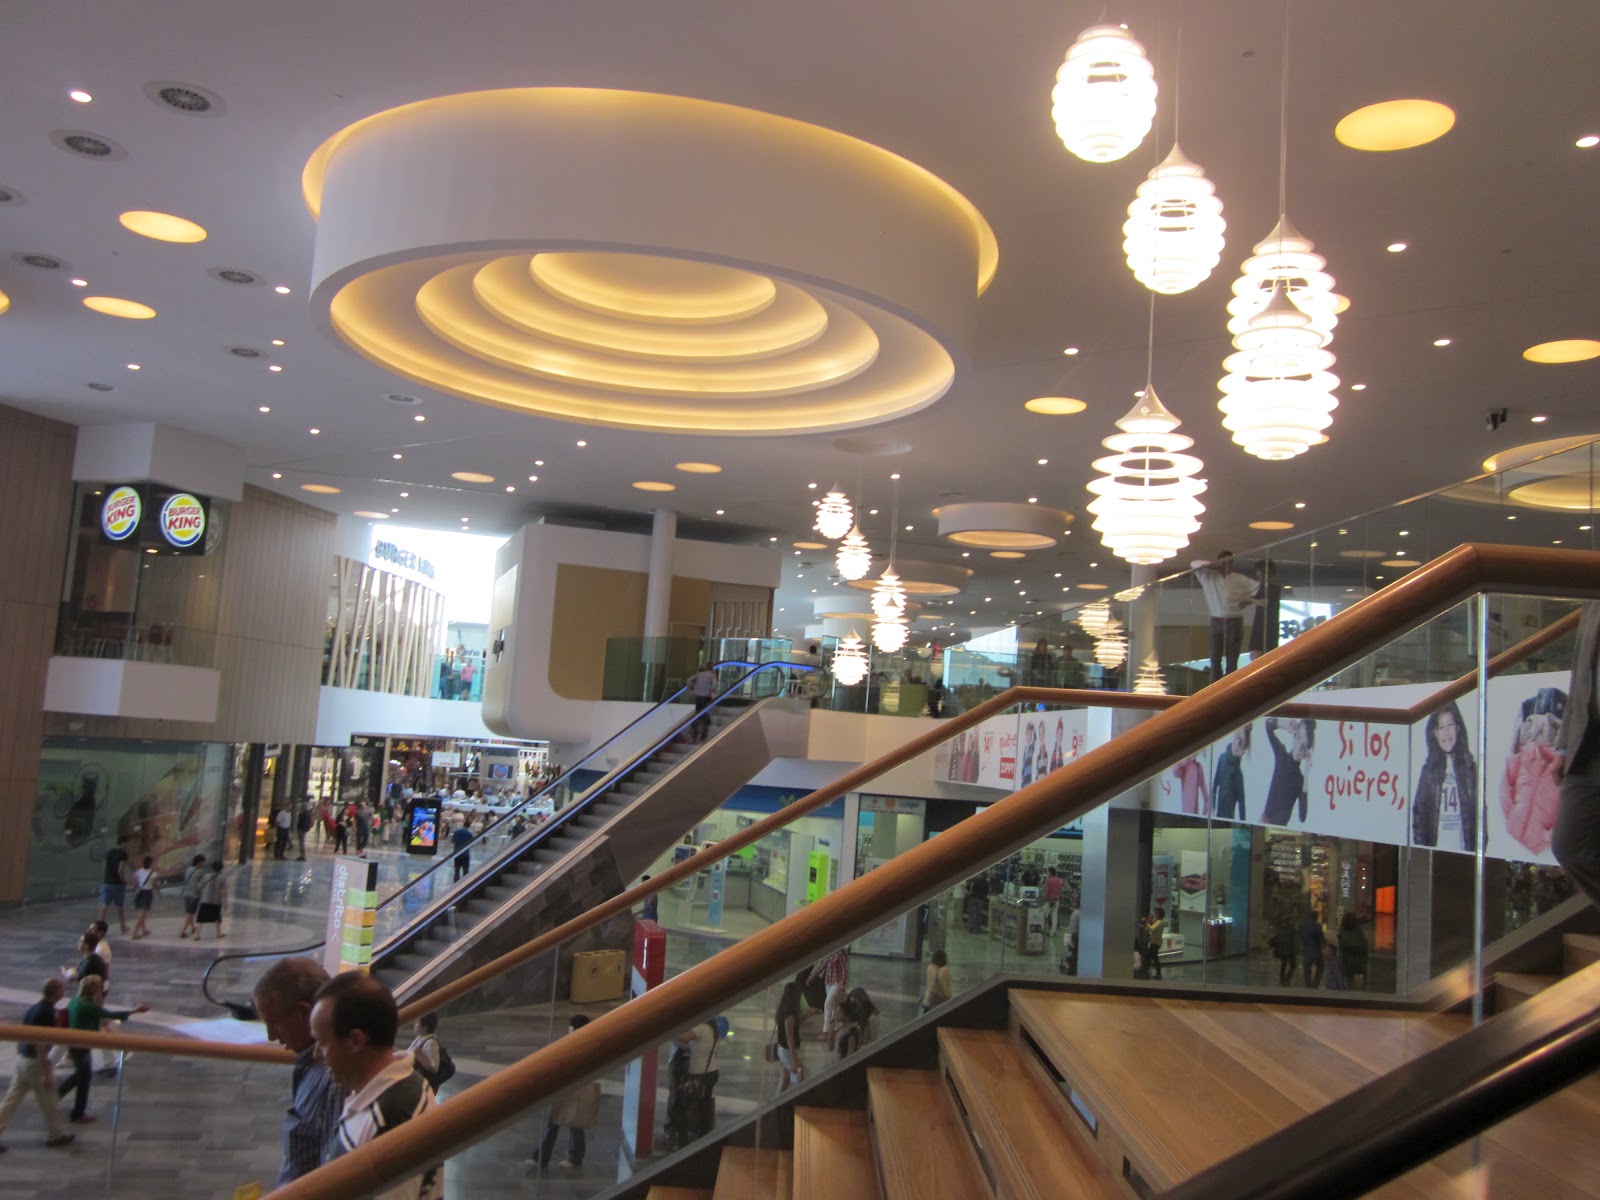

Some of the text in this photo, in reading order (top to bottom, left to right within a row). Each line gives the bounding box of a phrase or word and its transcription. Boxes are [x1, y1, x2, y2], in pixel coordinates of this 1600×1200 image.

[106, 495, 136, 512] BURGER
[168, 506, 202, 517] BURGER
[106, 505, 135, 526] KING
[167, 517, 201, 531] KING
[1338, 720, 1392, 762] Si los
[1325, 765, 1405, 811] quieres,
[1440, 786, 1459, 813] 14
